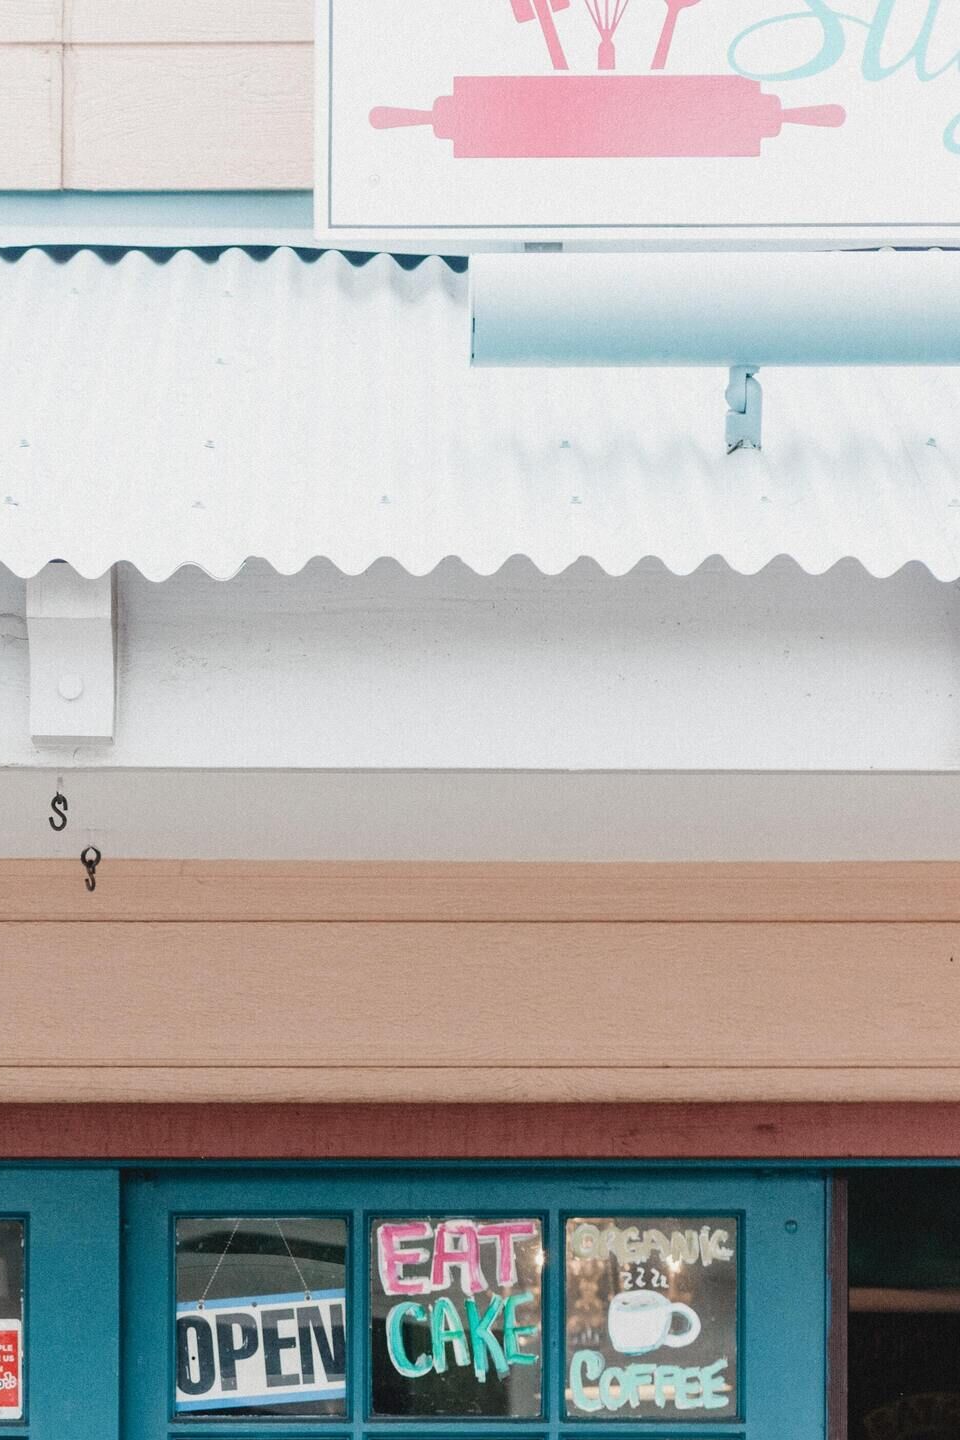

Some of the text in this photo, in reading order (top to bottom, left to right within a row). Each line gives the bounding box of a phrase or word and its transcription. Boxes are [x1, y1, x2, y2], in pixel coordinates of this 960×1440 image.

[377, 1219, 537, 1296] EAT
[572, 1224, 734, 1267] ORGANIC
[3, 1354, 14, 1362] US
[176, 1303, 346, 1395] OPEN
[386, 1291, 538, 1383] CAKE
[569, 1350, 730, 1412] COFFEE
